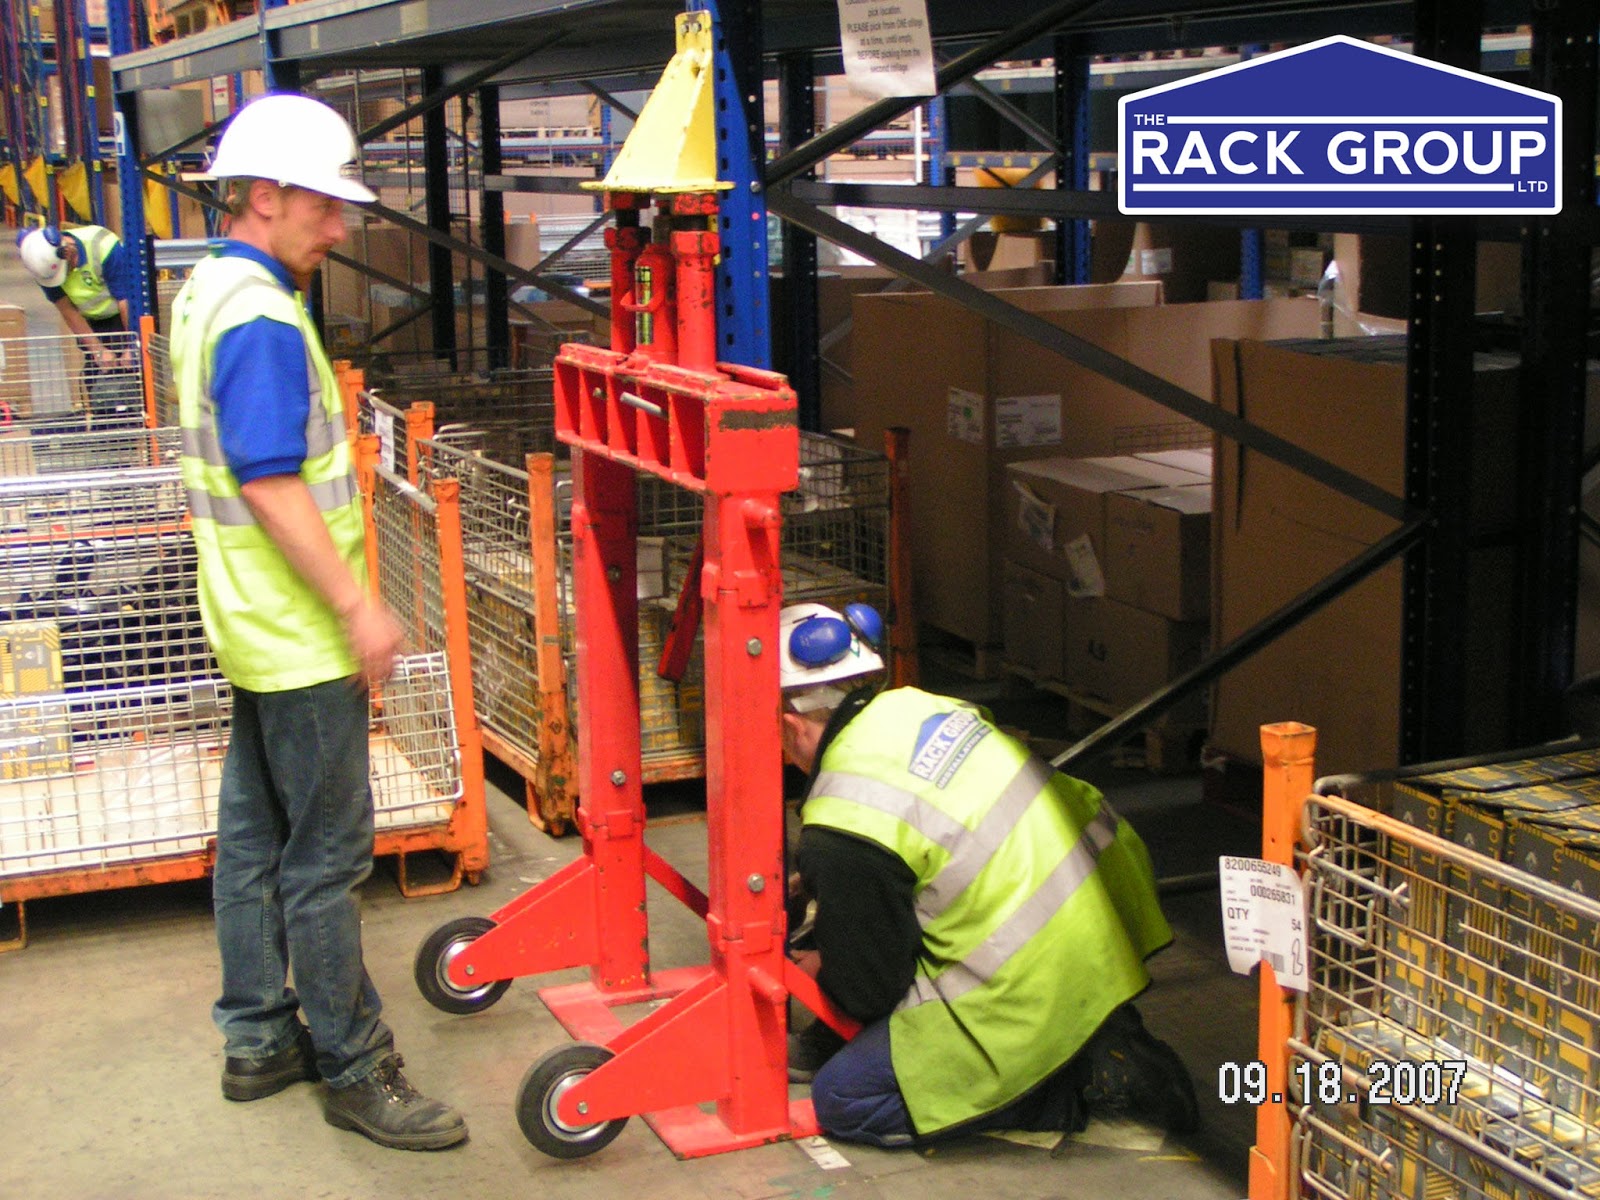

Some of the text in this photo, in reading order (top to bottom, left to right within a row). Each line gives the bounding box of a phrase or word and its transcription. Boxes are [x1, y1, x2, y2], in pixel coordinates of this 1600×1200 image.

[847, 21, 870, 33] PLEASE
[913, 735, 951, 778] RACK
[1227, 906, 1249, 920] QTY
